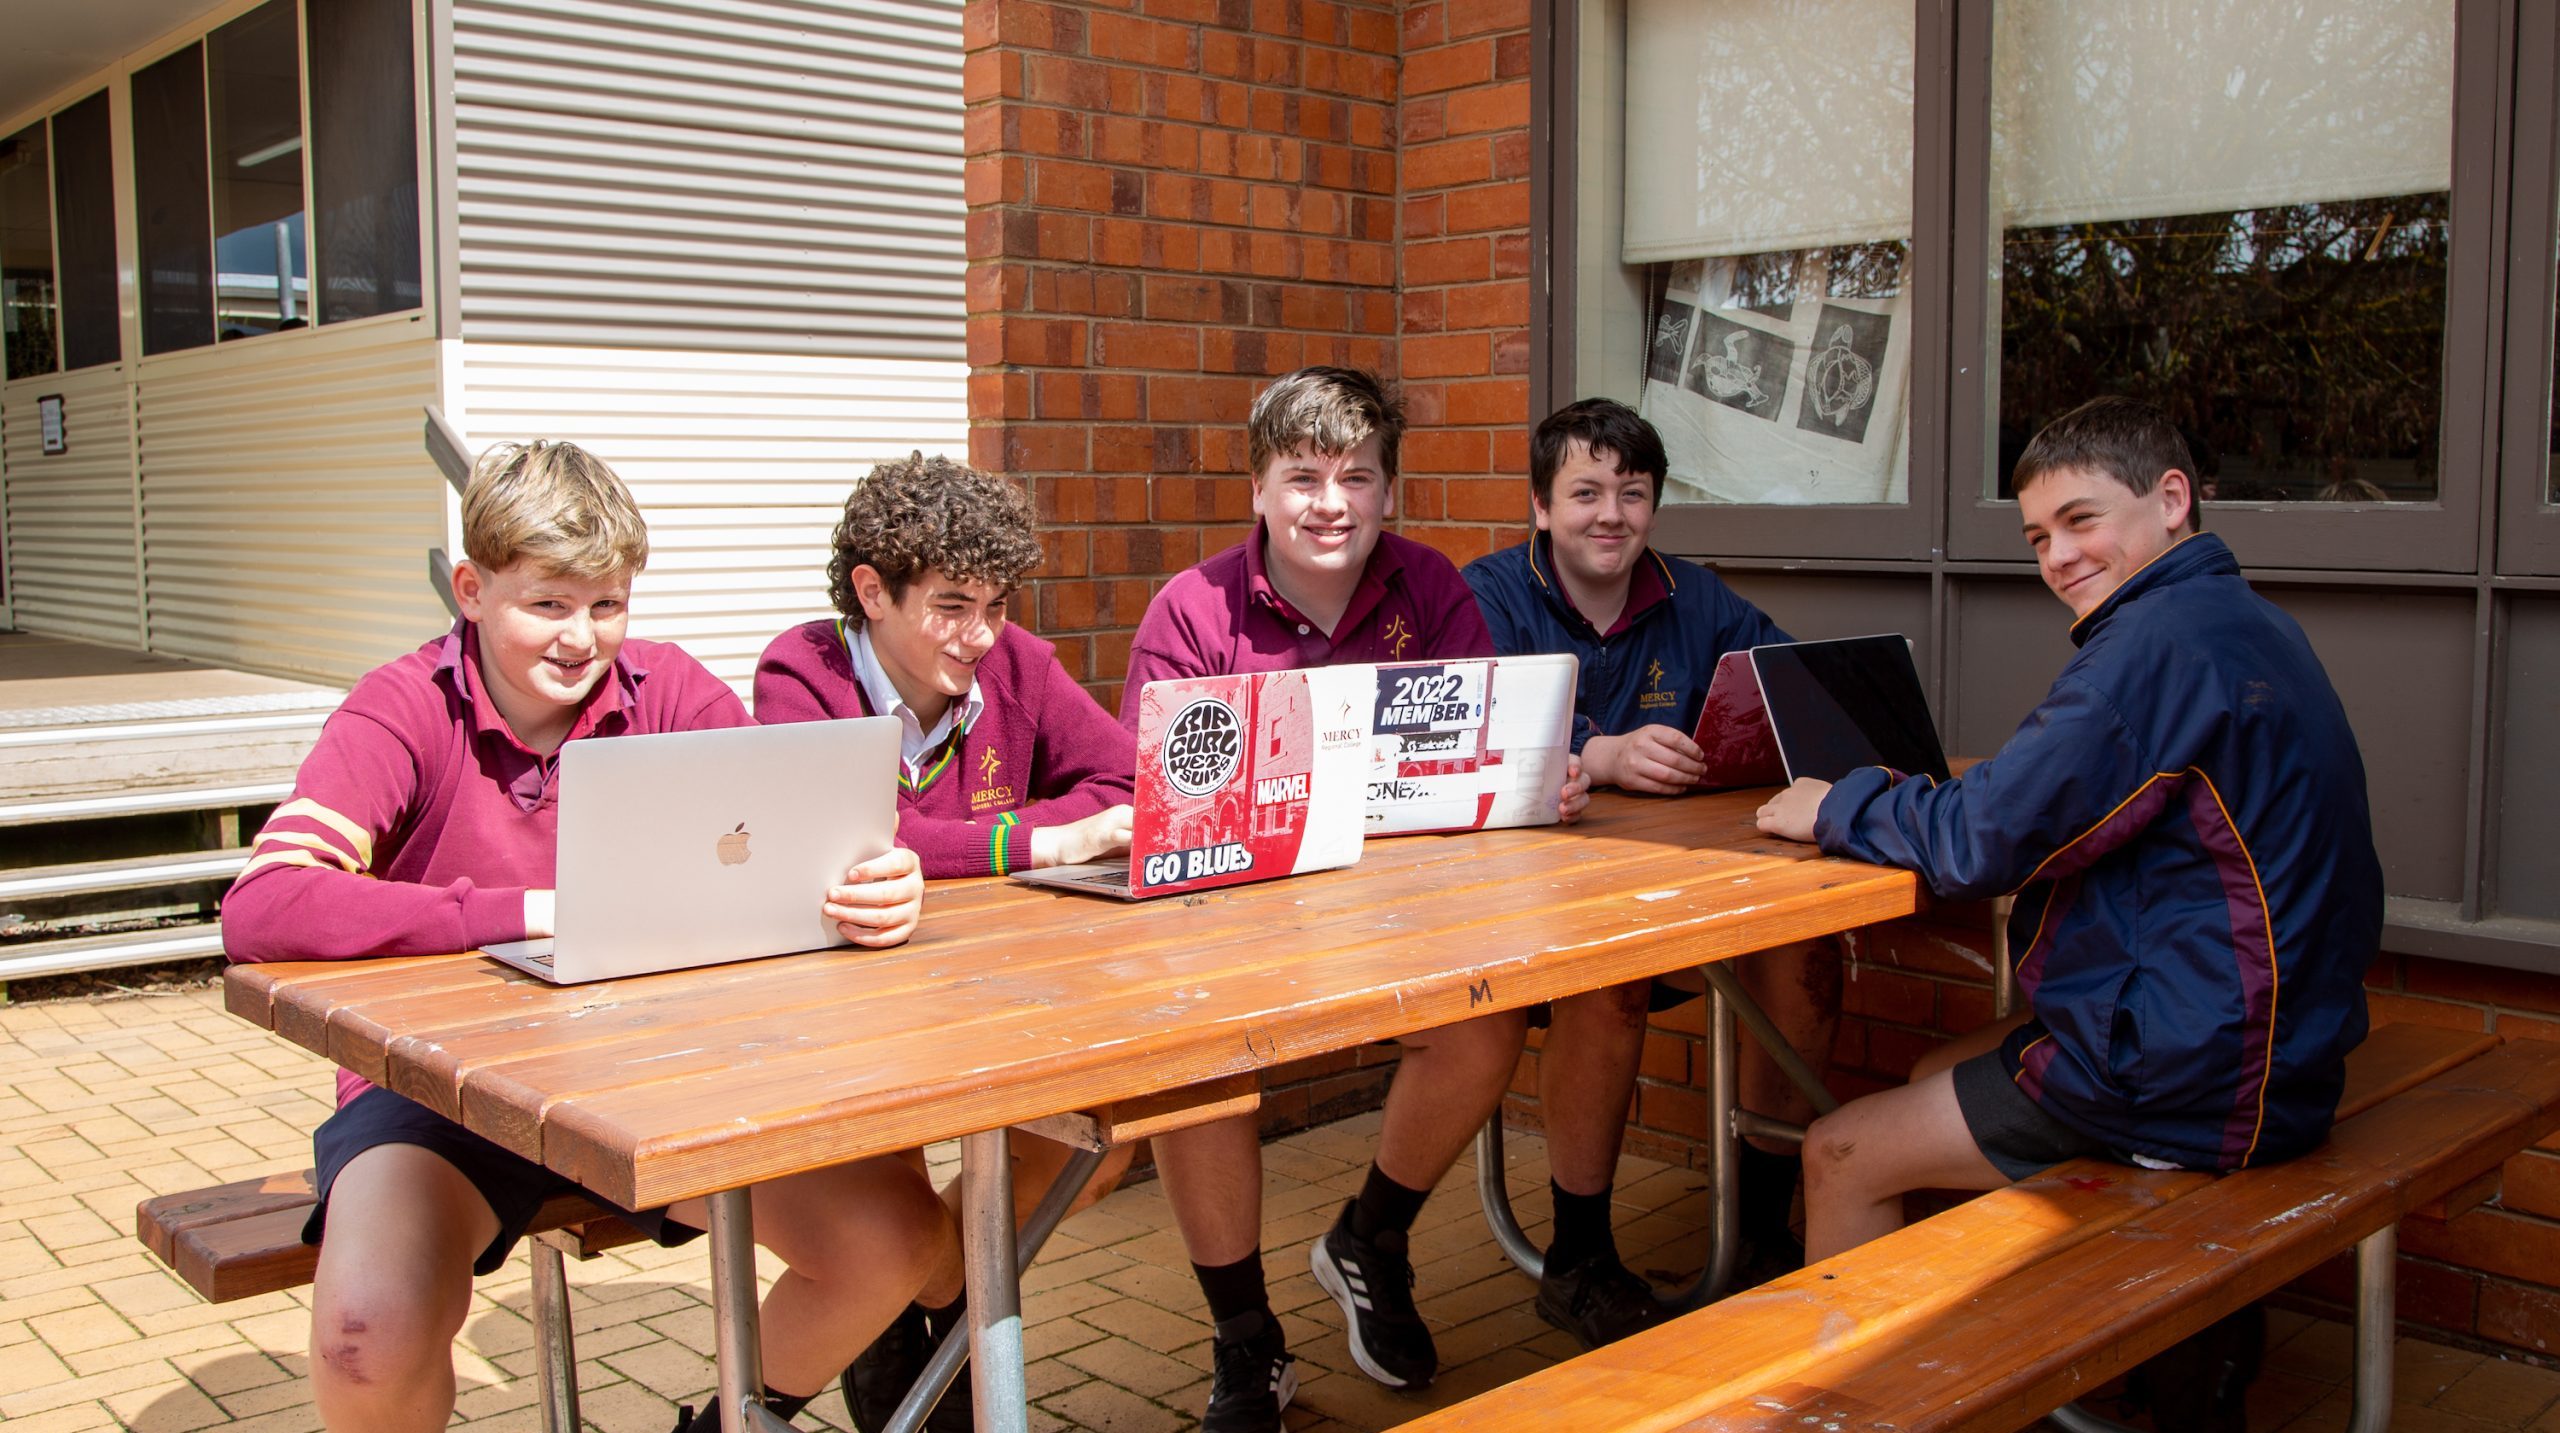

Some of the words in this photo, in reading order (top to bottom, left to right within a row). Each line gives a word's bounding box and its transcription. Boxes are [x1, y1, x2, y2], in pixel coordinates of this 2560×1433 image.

[1392, 675, 1463, 706] 2022
[1640, 691, 1676, 702] MERCY
[1174, 705, 1232, 736] RIP
[1380, 702, 1470, 726] MEMBER
[1169, 729, 1238, 759] CURL
[1321, 728, 1362, 742] MERCY
[971, 786, 1012, 804] MERCY
[1256, 773, 1309, 805] MARVEL
[1145, 853, 1181, 885] GO
[1186, 843, 1253, 879] BLUES
[1468, 978, 1494, 1009] M
